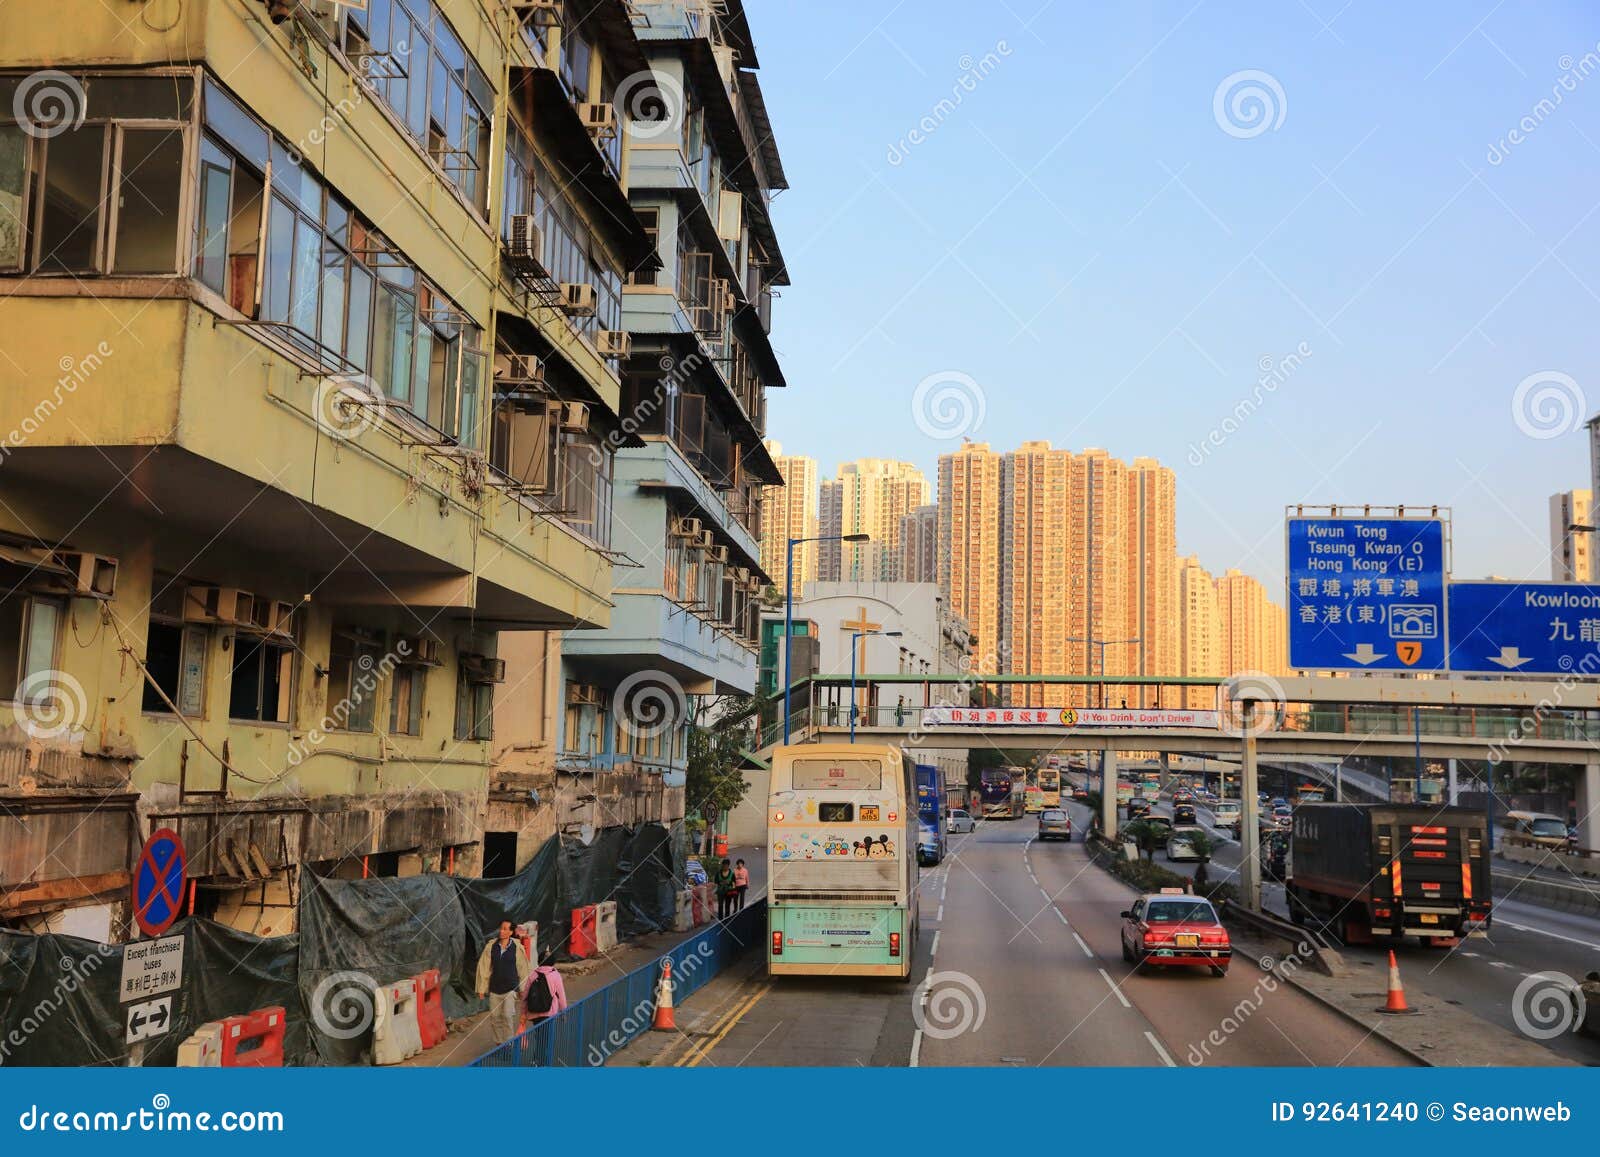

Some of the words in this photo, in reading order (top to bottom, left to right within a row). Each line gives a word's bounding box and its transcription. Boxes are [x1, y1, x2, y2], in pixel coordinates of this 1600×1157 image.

[1308, 525, 1344, 538] Kwun
[1354, 525, 1387, 540] Tong
[1308, 541, 1355, 556] Tseung
[1365, 542, 1402, 554] Kwan
[1412, 541, 1423, 554] O
[1308, 558, 1343, 573] Hong
[1352, 558, 1388, 573] Kong
[1399, 556, 1423, 571] (E)
[1525, 591, 1600, 608] Kowloon
[1299, 604, 1386, 624] 香港(東)
[1425, 623, 1432, 634] E
[1549, 616, 1600, 642] 九龍
[1404, 646, 1415, 661] 7
[1083, 713, 1089, 721] If
[1092, 713, 1108, 721] You
[1111, 713, 1137, 723] Drink,
[1140, 713, 1165, 722] Don't
[1167, 714, 1195, 723] Drive!
[127, 946, 148, 961] Except
[143, 960, 162, 971] buses
